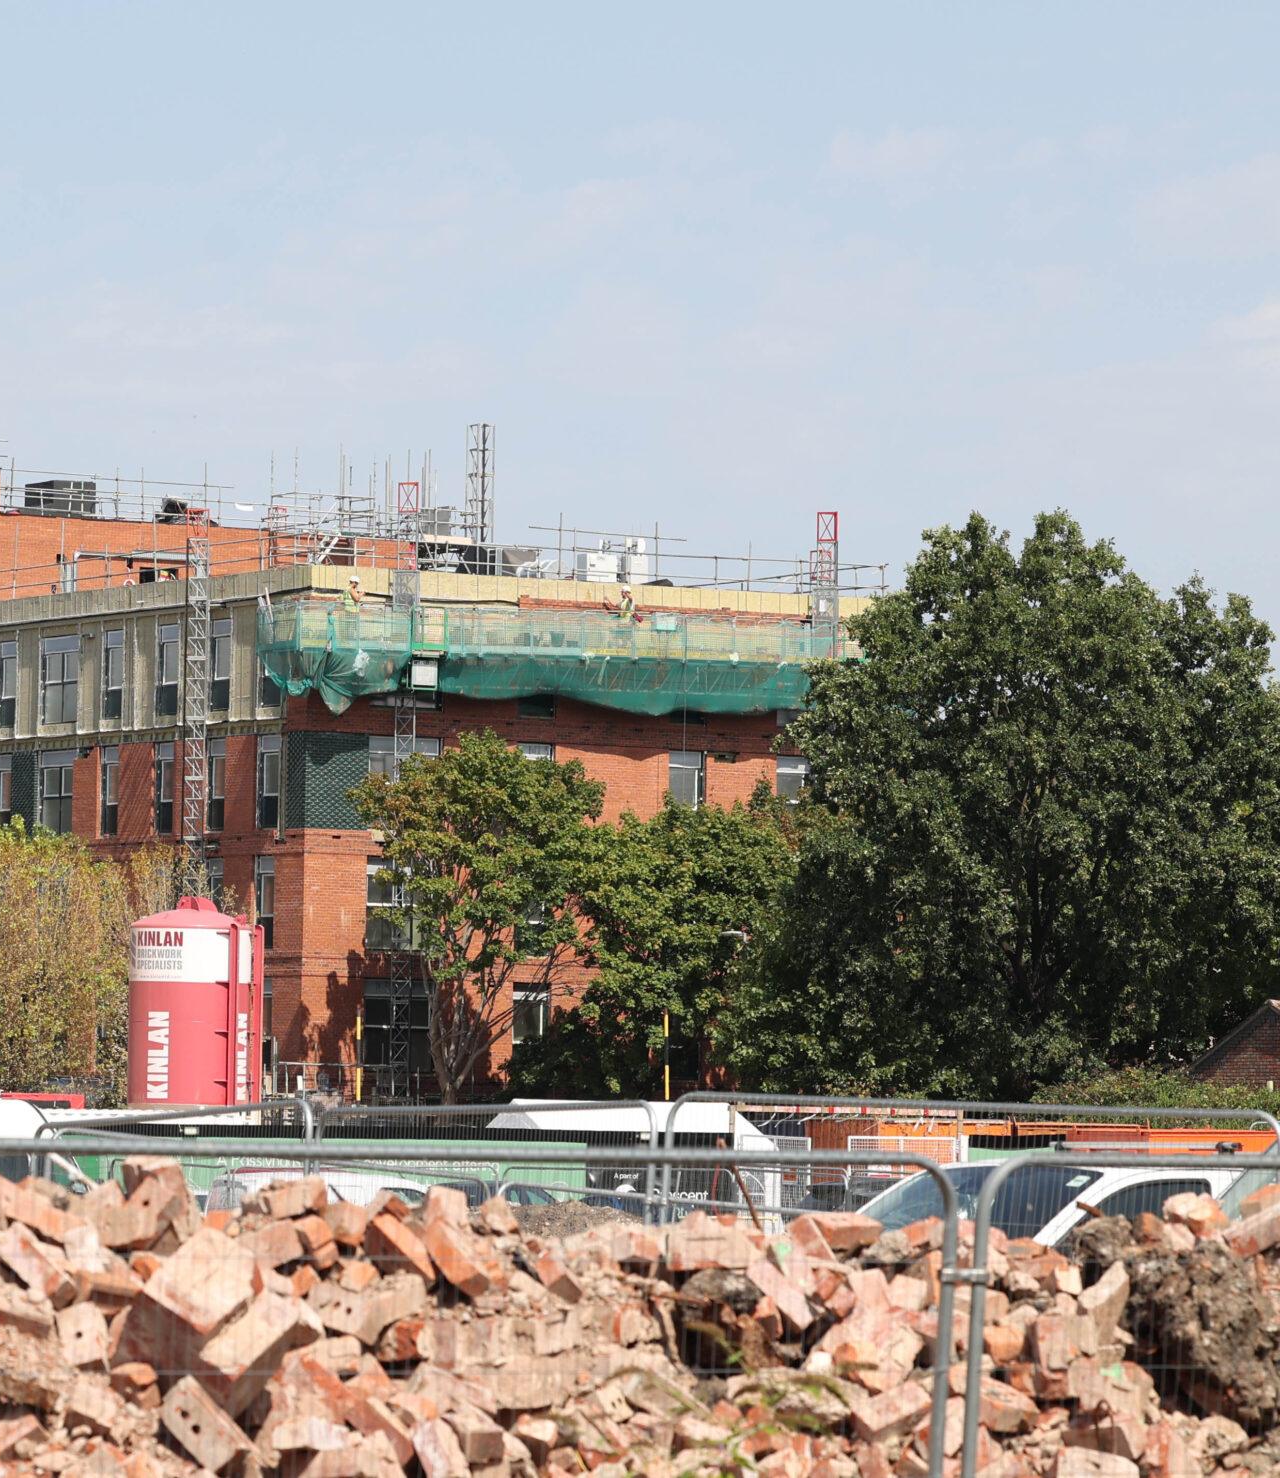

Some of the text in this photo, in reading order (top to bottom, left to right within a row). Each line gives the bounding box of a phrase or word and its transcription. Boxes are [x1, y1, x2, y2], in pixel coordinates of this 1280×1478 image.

[137, 930, 183, 947] KINLAN
[136, 960, 183, 970] SPECIALISTS
[146, 1011, 169, 1099] KINLAN
